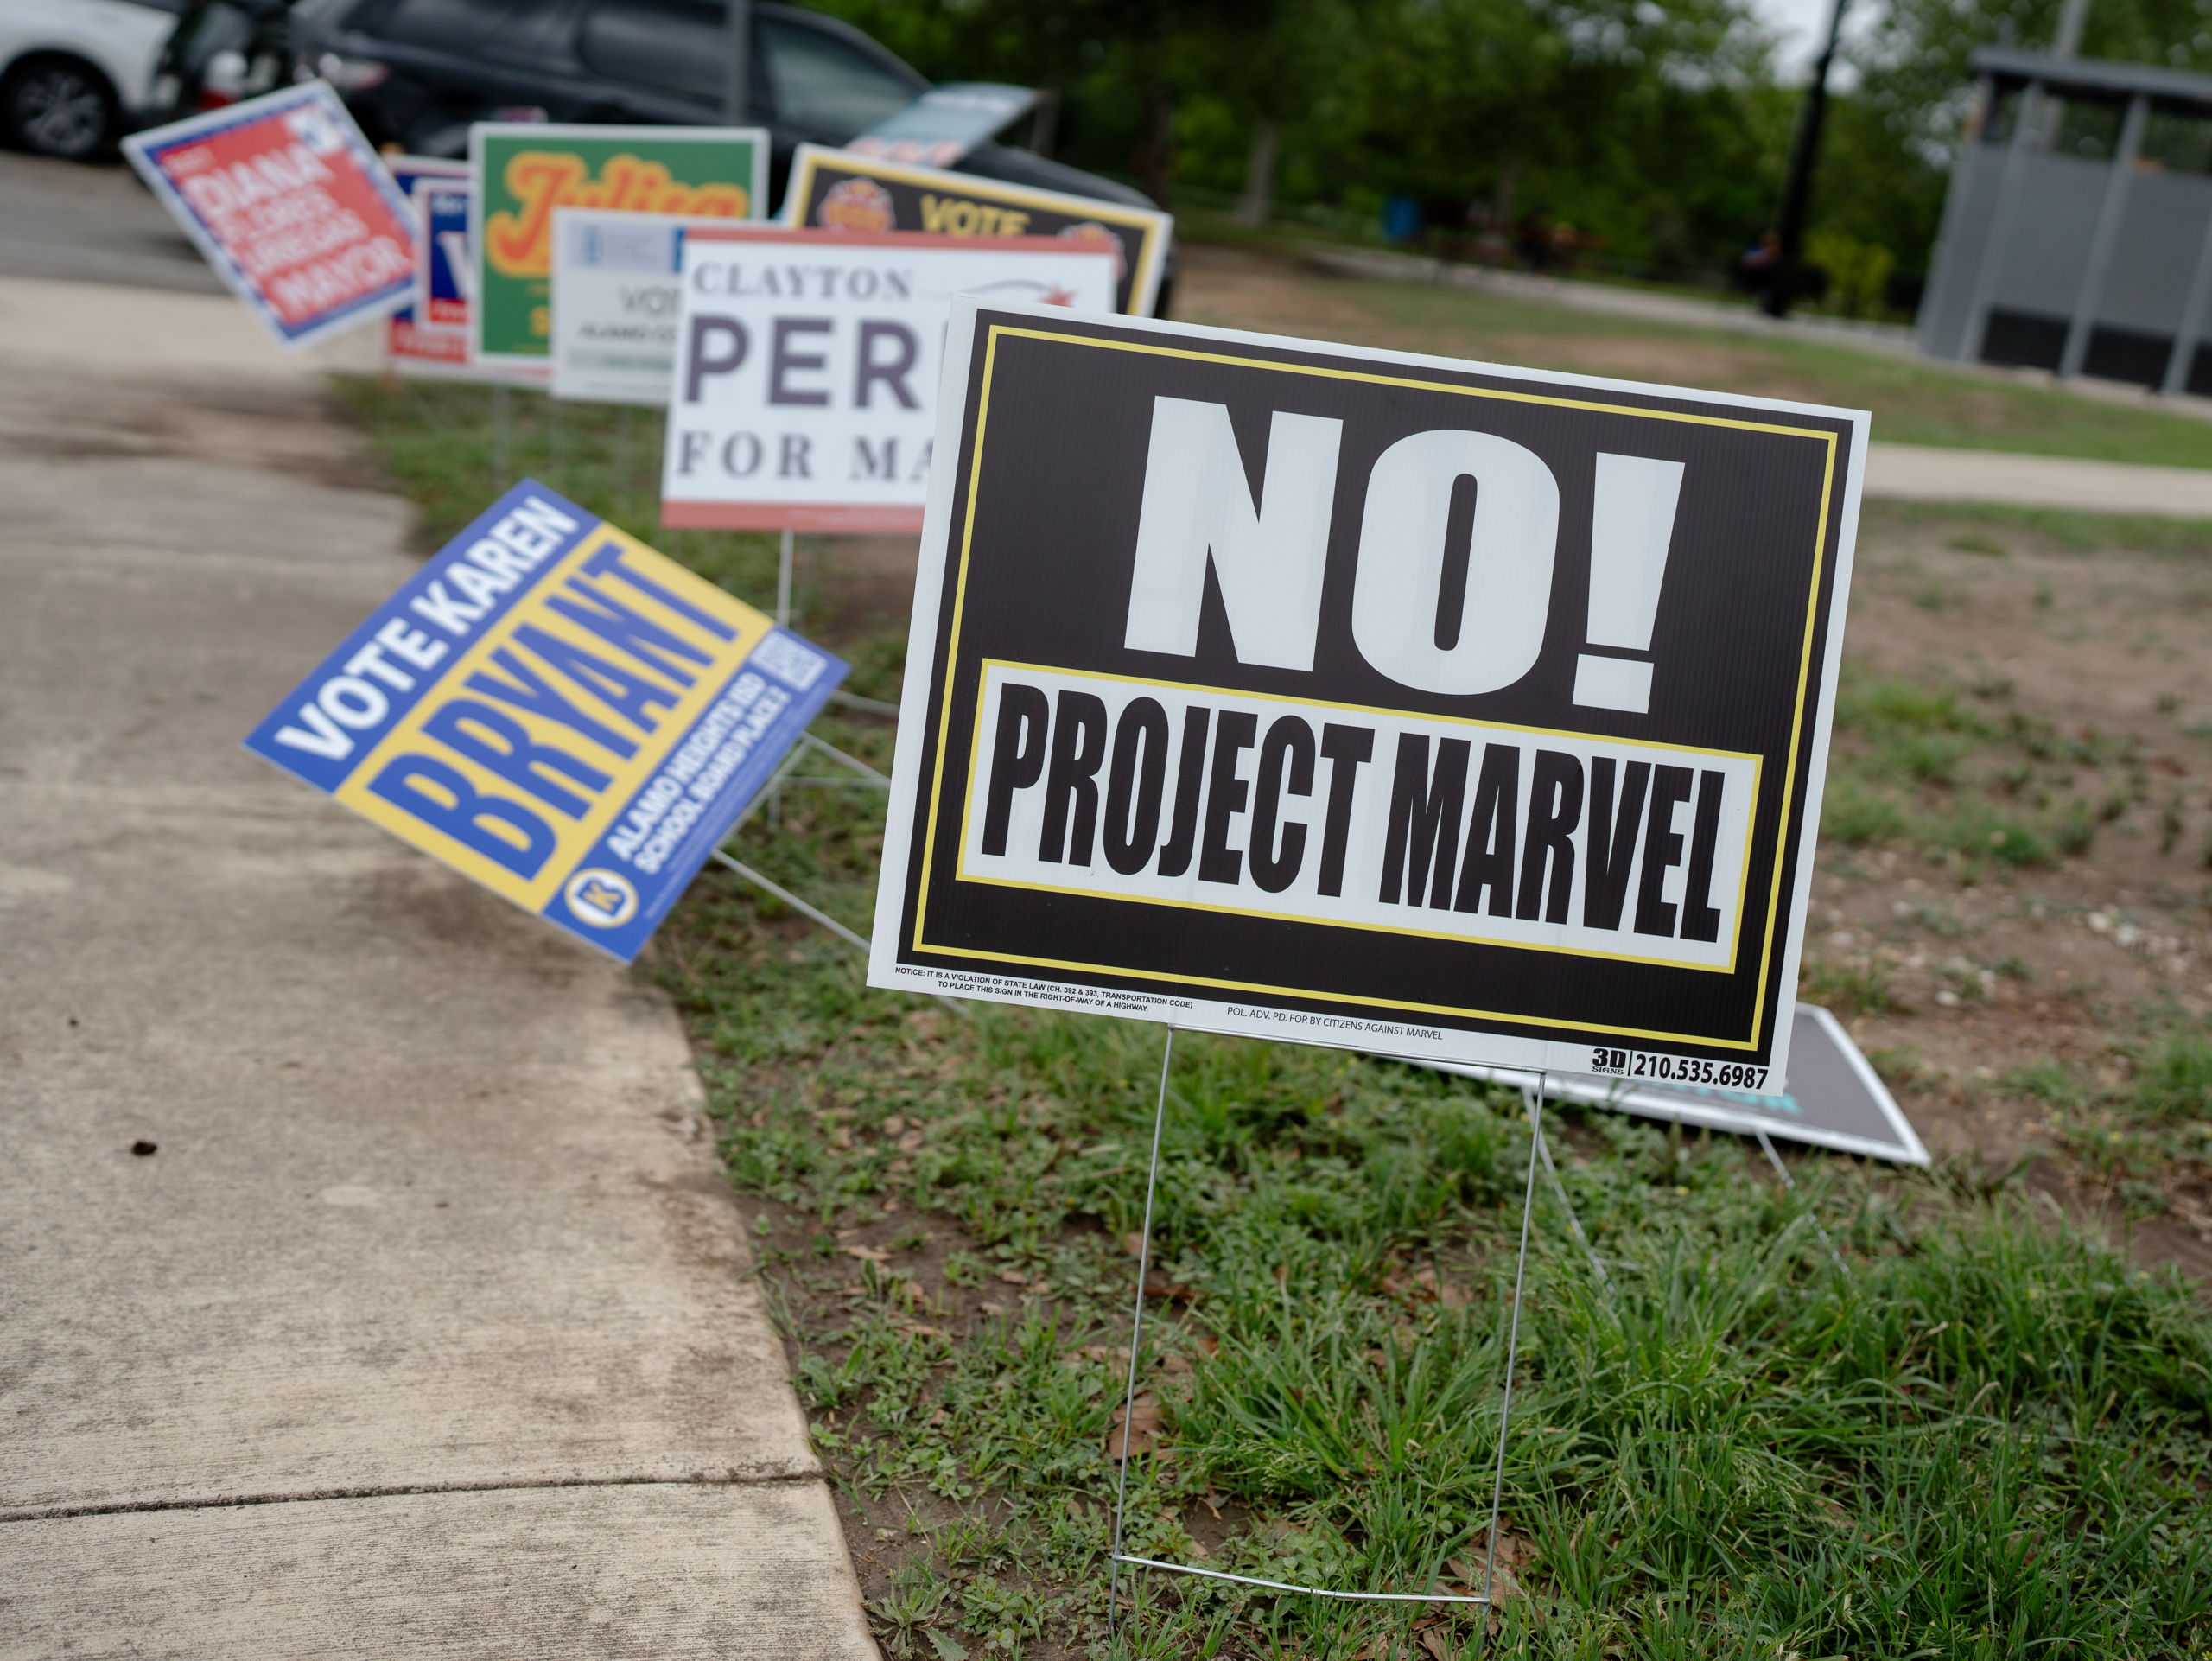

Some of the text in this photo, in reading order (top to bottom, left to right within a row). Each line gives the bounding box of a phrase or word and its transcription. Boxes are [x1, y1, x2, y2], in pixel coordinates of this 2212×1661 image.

[183, 142, 337, 216] DIANA
[489, 156, 745, 273] Jlia
[919, 194, 1032, 236] VOTE
[272, 235, 413, 320] MAYOR
[617, 284, 683, 318] VOT
[693, 261, 914, 302] CLAYTON
[684, 314, 950, 410] PER
[677, 430, 813, 479] FOR
[1123, 394, 1686, 715] NO!
[274, 495, 580, 761] VOTE KAREN
[364, 540, 739, 883] BRYANT
[607, 672, 766, 862] ALAMO HEIGHTS ISD
[633, 797, 706, 875] SCHOOL
[690, 745, 747, 803] BOARD
[730, 697, 782, 750] PLACE
[980, 680, 1376, 899] PROJECT
[1379, 730, 1725, 944] MARVEL
[895, 966, 925, 977] NOTICE:
[951, 974, 990, 984] VIOLATION
[1004, 980, 1027, 989] STATE
[1085, 989, 1099, 997] 393,
[1101, 991, 1167, 1005] TRANSPORTATION
[1169, 1000, 1193, 1009] CODE)
[950, 983, 975, 991] PLACE
[995, 987, 1013, 996] SIGN
[1040, 993, 1093, 1005] RIGHT-OF-WAY
[1113, 1002, 1148, 1012] HIGHWAY.
[1227, 1007, 1443, 1041] POL. ADV. PD. FOR BY CITIZENS AGAINST MARVEL
[1592, 1047, 1769, 1090] 3D 210.535.6987
[1592, 1066, 1624, 1075] SIGNS
